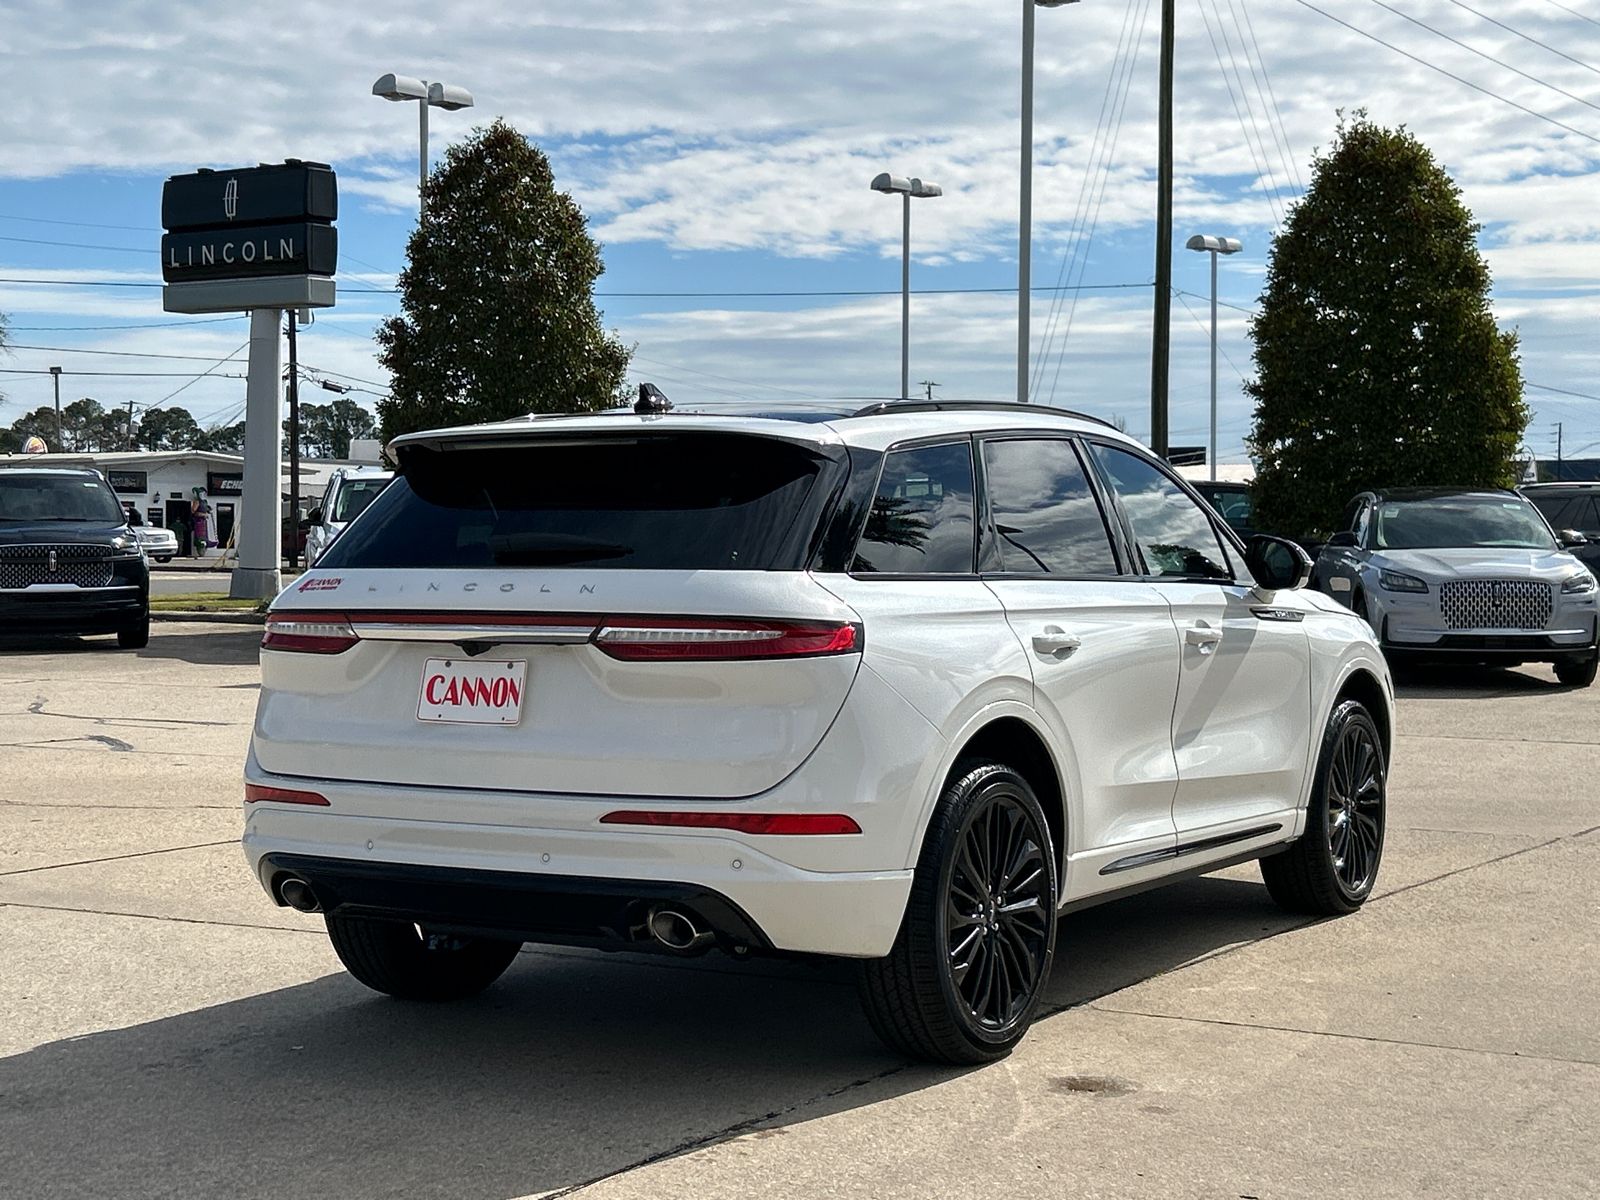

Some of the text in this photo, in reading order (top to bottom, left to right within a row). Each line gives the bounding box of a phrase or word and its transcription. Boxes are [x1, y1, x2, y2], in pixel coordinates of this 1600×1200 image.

[170, 237, 294, 268] LINCOLN
[368, 582, 597, 594] LINCOLN
[425, 674, 522, 708] CANNON
